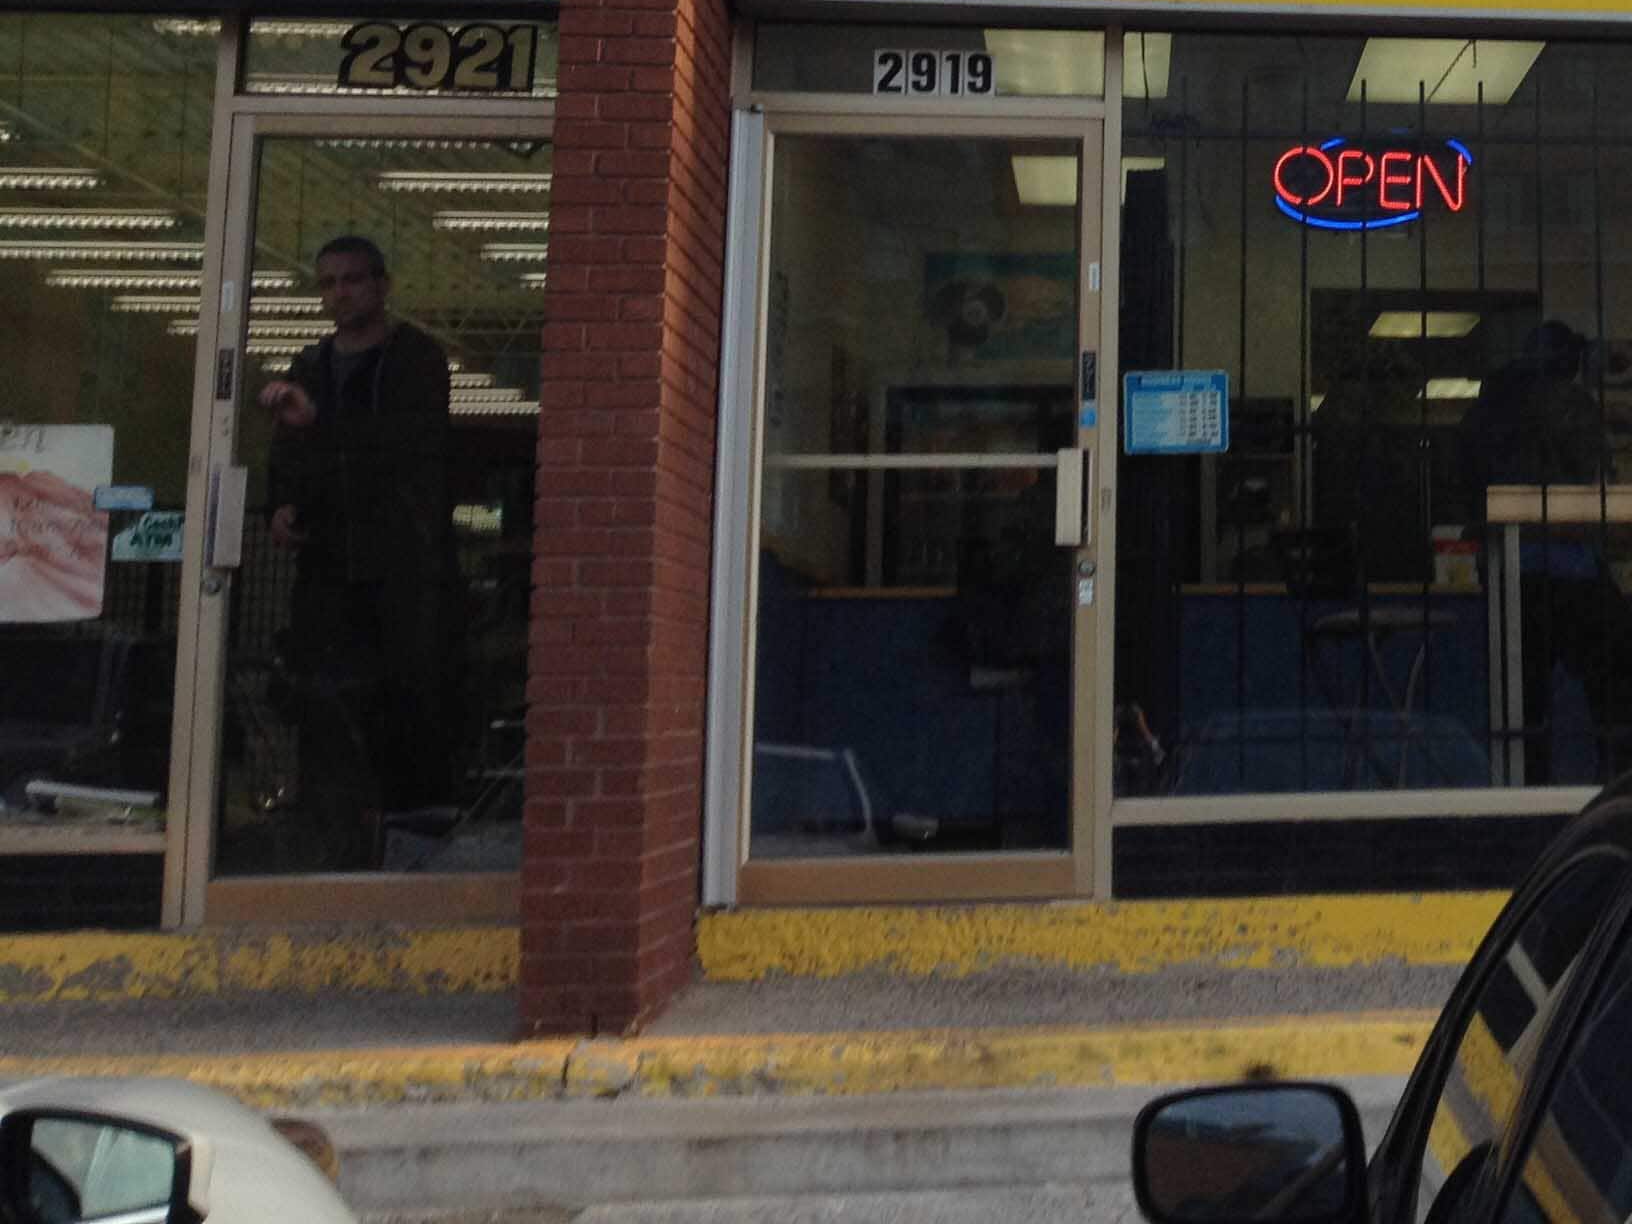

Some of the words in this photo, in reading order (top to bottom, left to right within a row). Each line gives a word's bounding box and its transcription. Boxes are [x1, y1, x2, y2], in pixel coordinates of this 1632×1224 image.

[338, 22, 537, 92] 2921
[877, 52, 993, 94] 2919
[1274, 145, 1467, 212] OPEN
